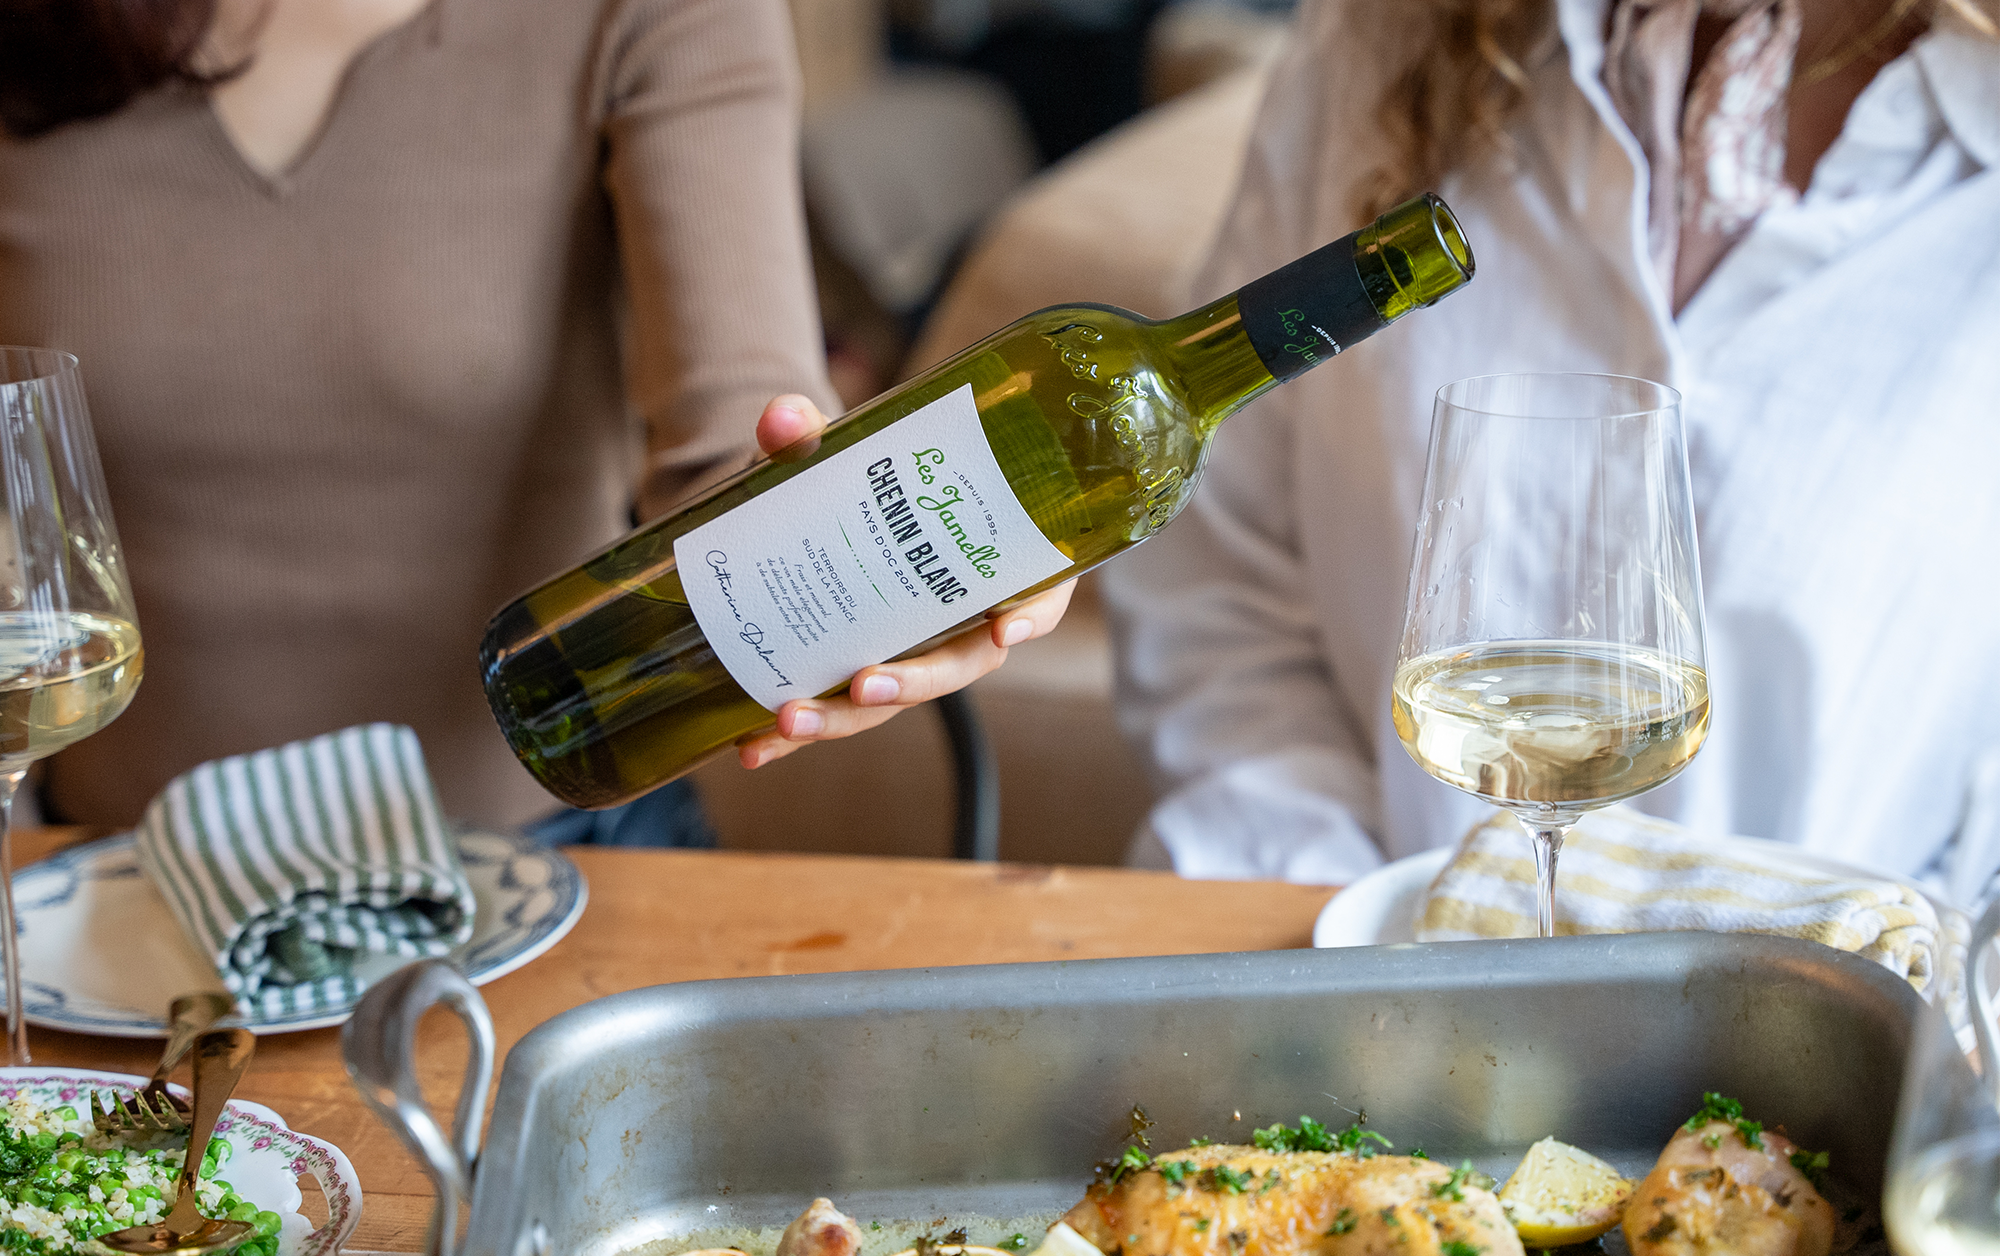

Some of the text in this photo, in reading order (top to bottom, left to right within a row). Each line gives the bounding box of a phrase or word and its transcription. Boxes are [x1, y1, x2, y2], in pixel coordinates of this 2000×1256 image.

[1038, 323, 1103, 381] Les
[1278, 308, 1305, 336] Les
[866, 457, 969, 605] CHENIN BLANC
[912, 448, 1001, 579] Les Jamelles
[759, 568, 768, 577] de
[818, 546, 857, 608] TERROIRS DU
[858, 500, 920, 598] PAYS D'OC 2024
[763, 579, 780, 605] subtiles
[767, 557, 820, 642] de délicats parfums fruités
[778, 556, 829, 634] ce vin mêle élégamment
[794, 564, 832, 618] Frais et minéral,
[802, 538, 857, 624] SUD DE LA FRANCE
[706, 550, 793, 688] Catherine Delaunay
[778, 605, 792, 624] notes
[785, 623, 810, 648] florales.
